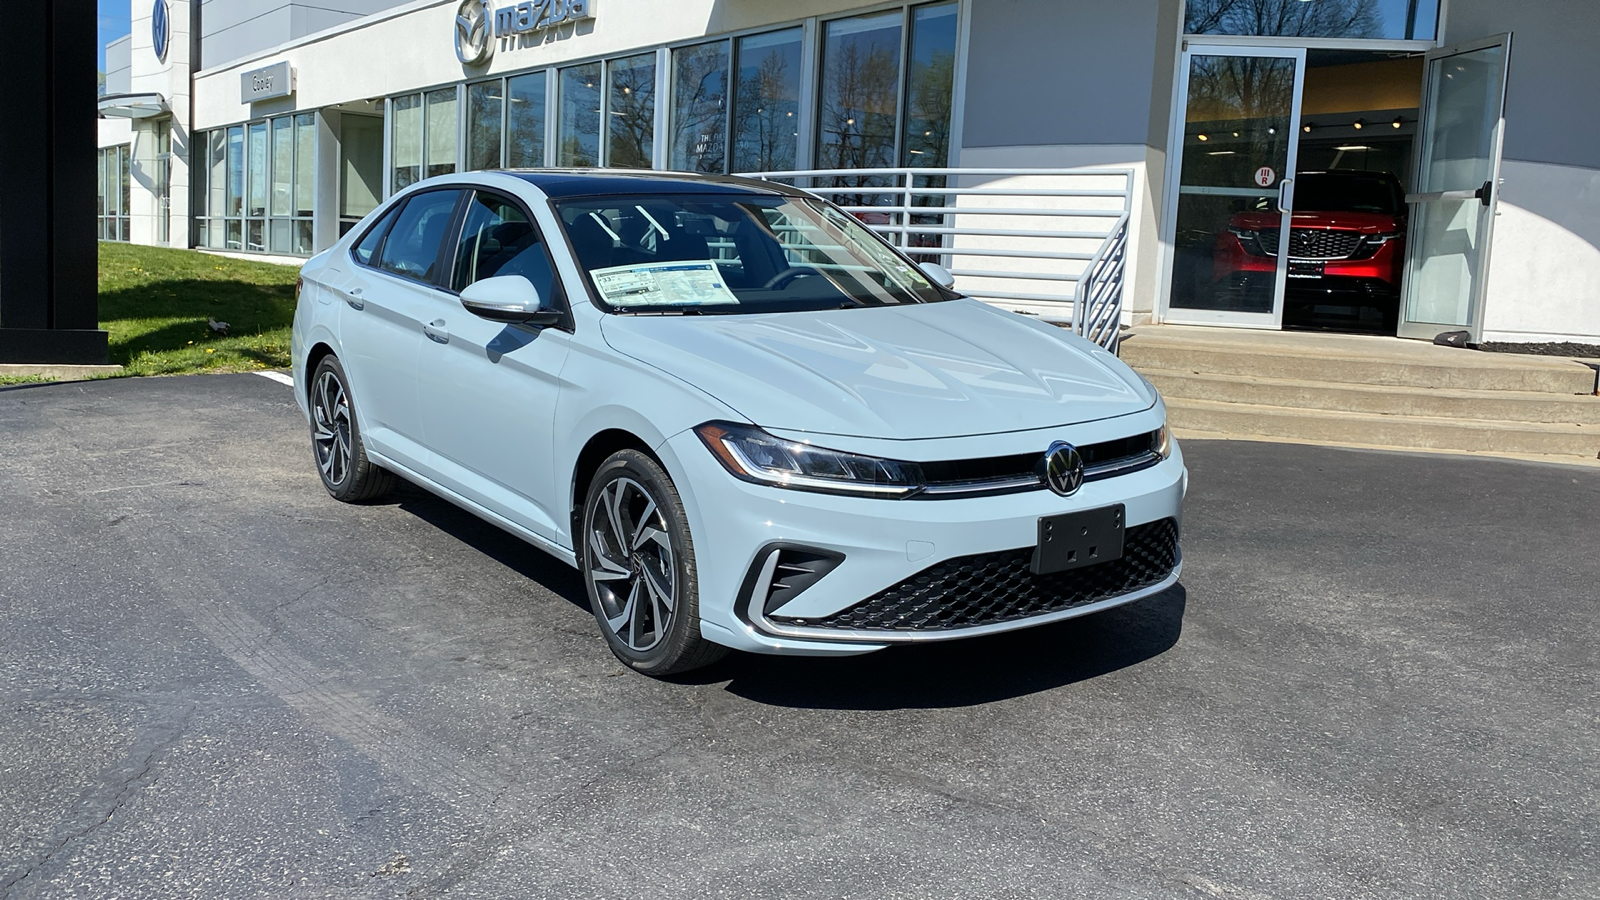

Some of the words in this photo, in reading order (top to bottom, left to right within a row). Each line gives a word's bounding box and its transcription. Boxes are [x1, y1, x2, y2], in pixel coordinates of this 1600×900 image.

[495, 0, 589, 38] mazda
[252, 71, 274, 93] Cooley
[1261, 176, 1268, 185] R
